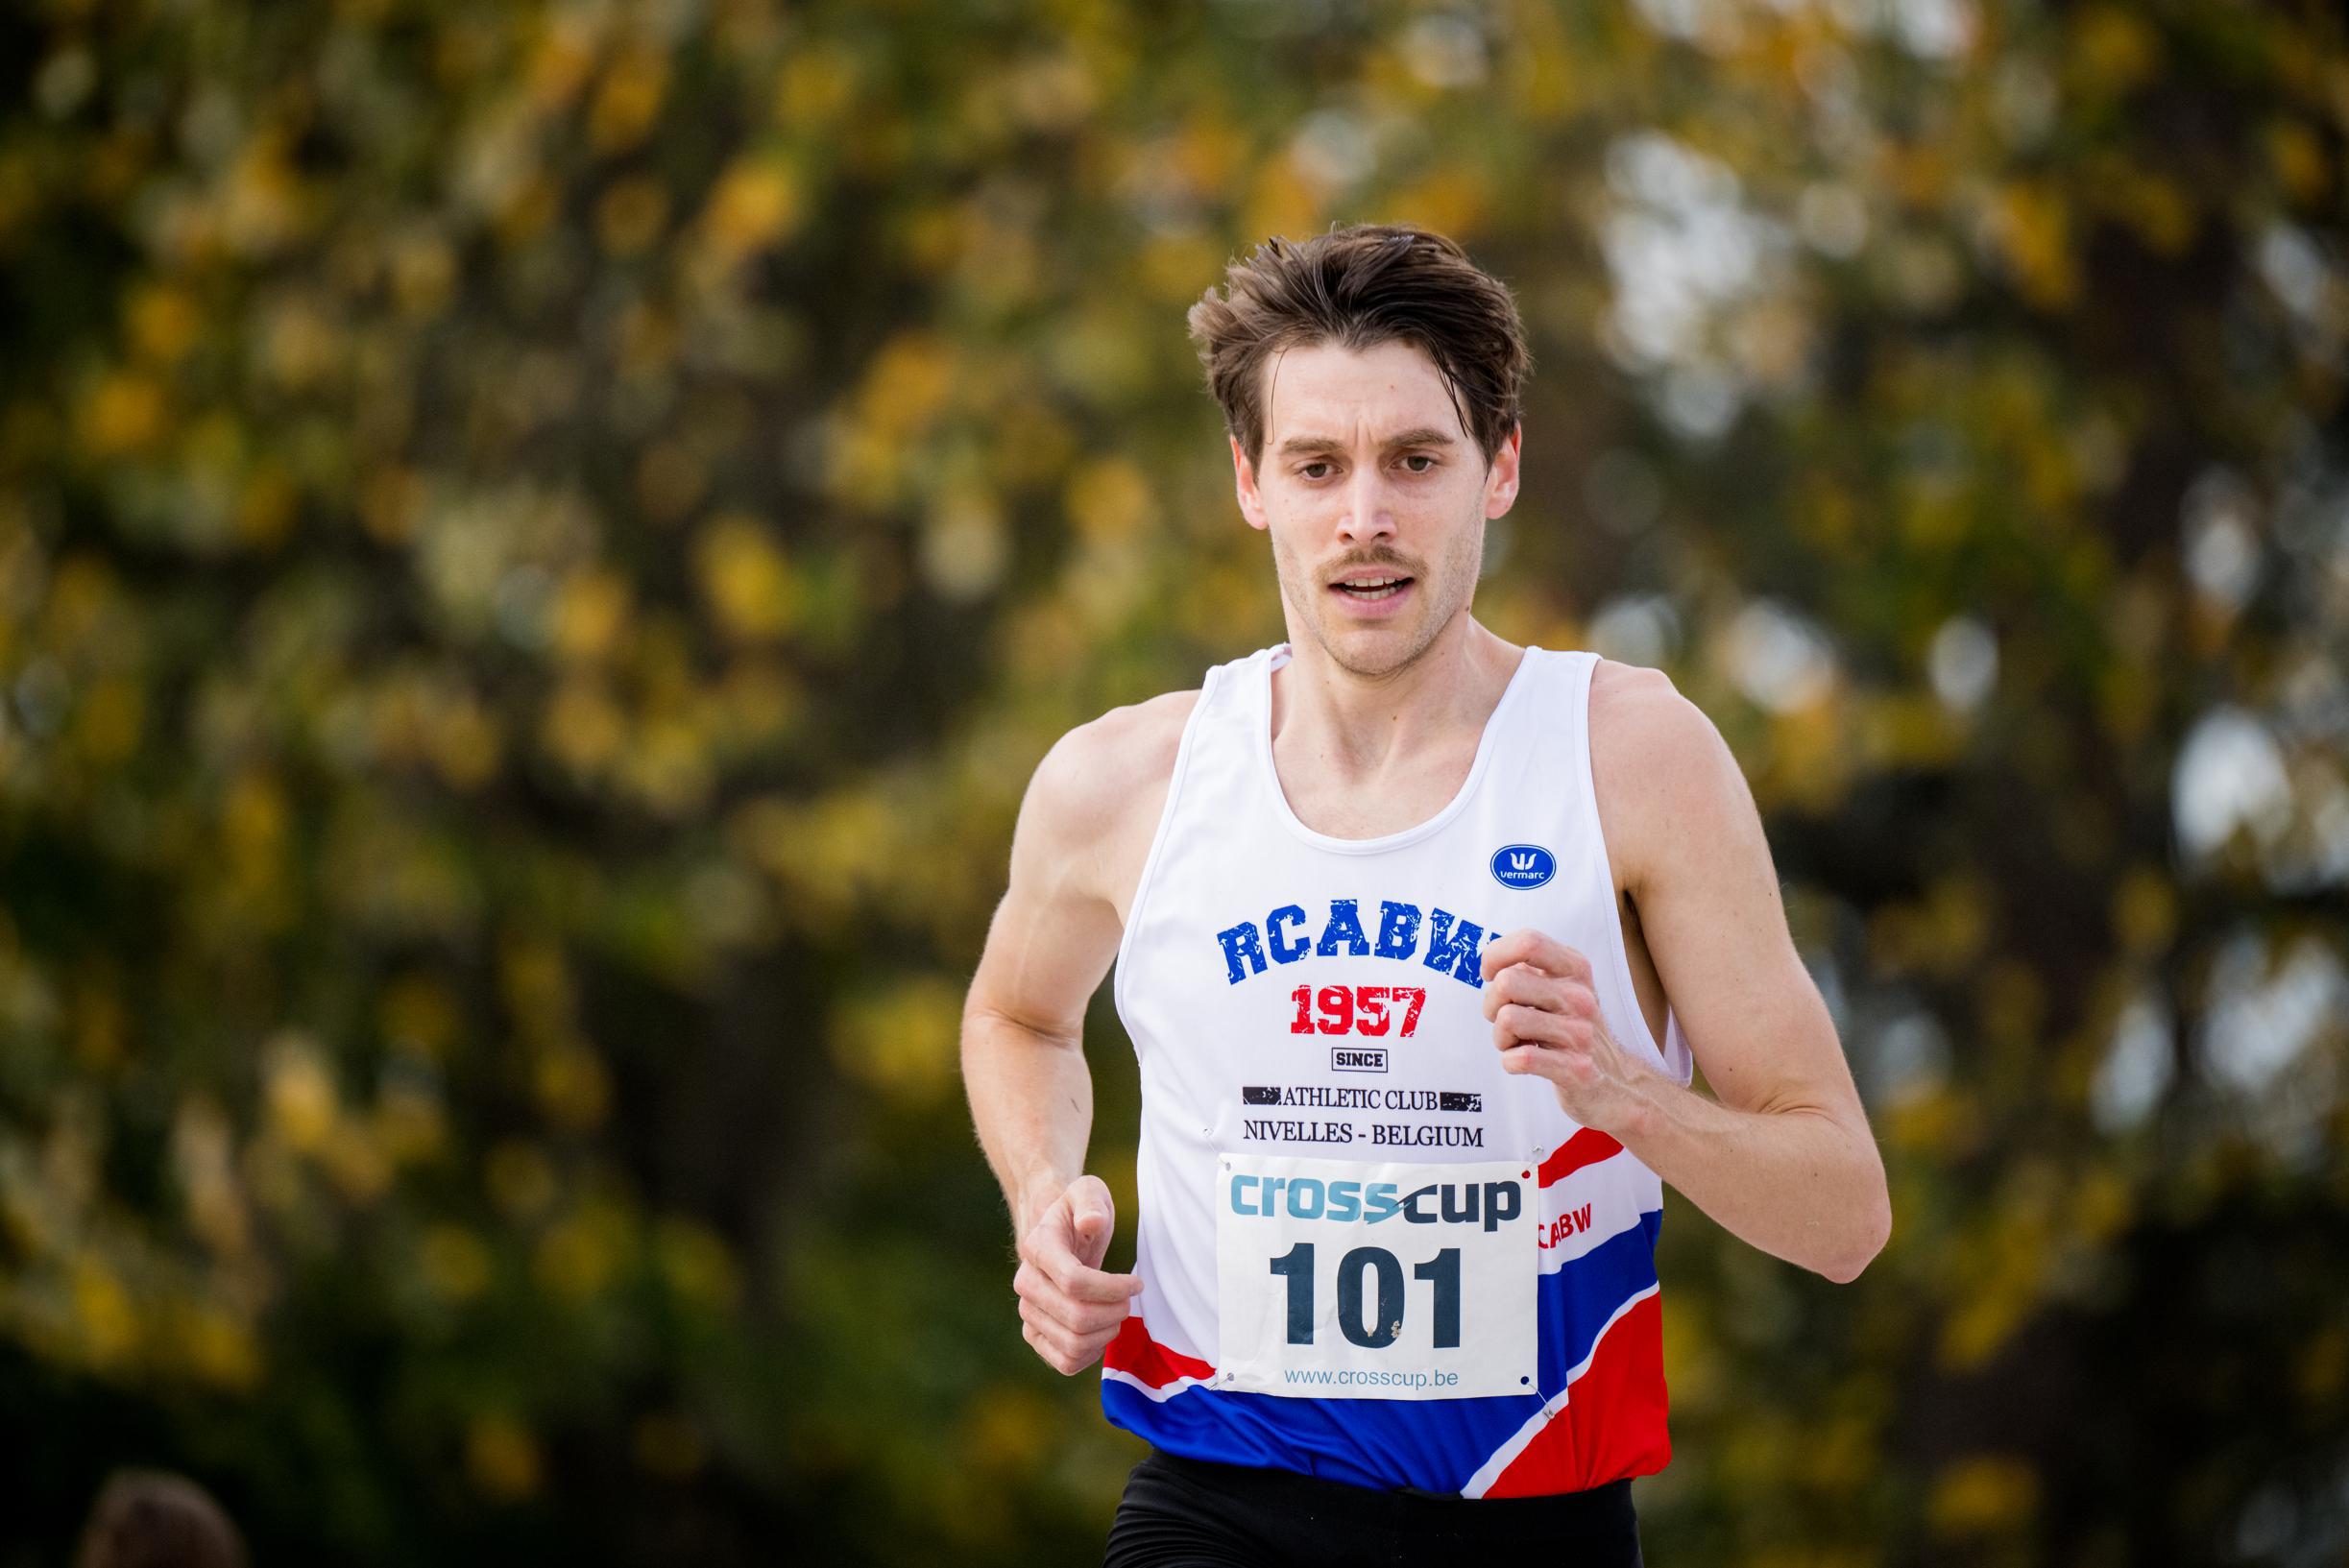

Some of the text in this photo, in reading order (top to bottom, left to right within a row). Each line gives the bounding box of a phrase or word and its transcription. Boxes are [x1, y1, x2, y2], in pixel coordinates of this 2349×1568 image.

[1500, 870, 1545, 880] vermarc
[1291, 984, 1426, 1038] 1957
[1336, 1052, 1384, 1068] SINCE
[1283, 1087, 1438, 1110] ATHLETIC CLUB
[1244, 1121, 1353, 1143] NIVELLES
[1371, 1124, 1484, 1147] BELGIUM
[1270, 1242, 1461, 1349] 101
[1285, 1368, 1459, 1390] www.crosscup.be
